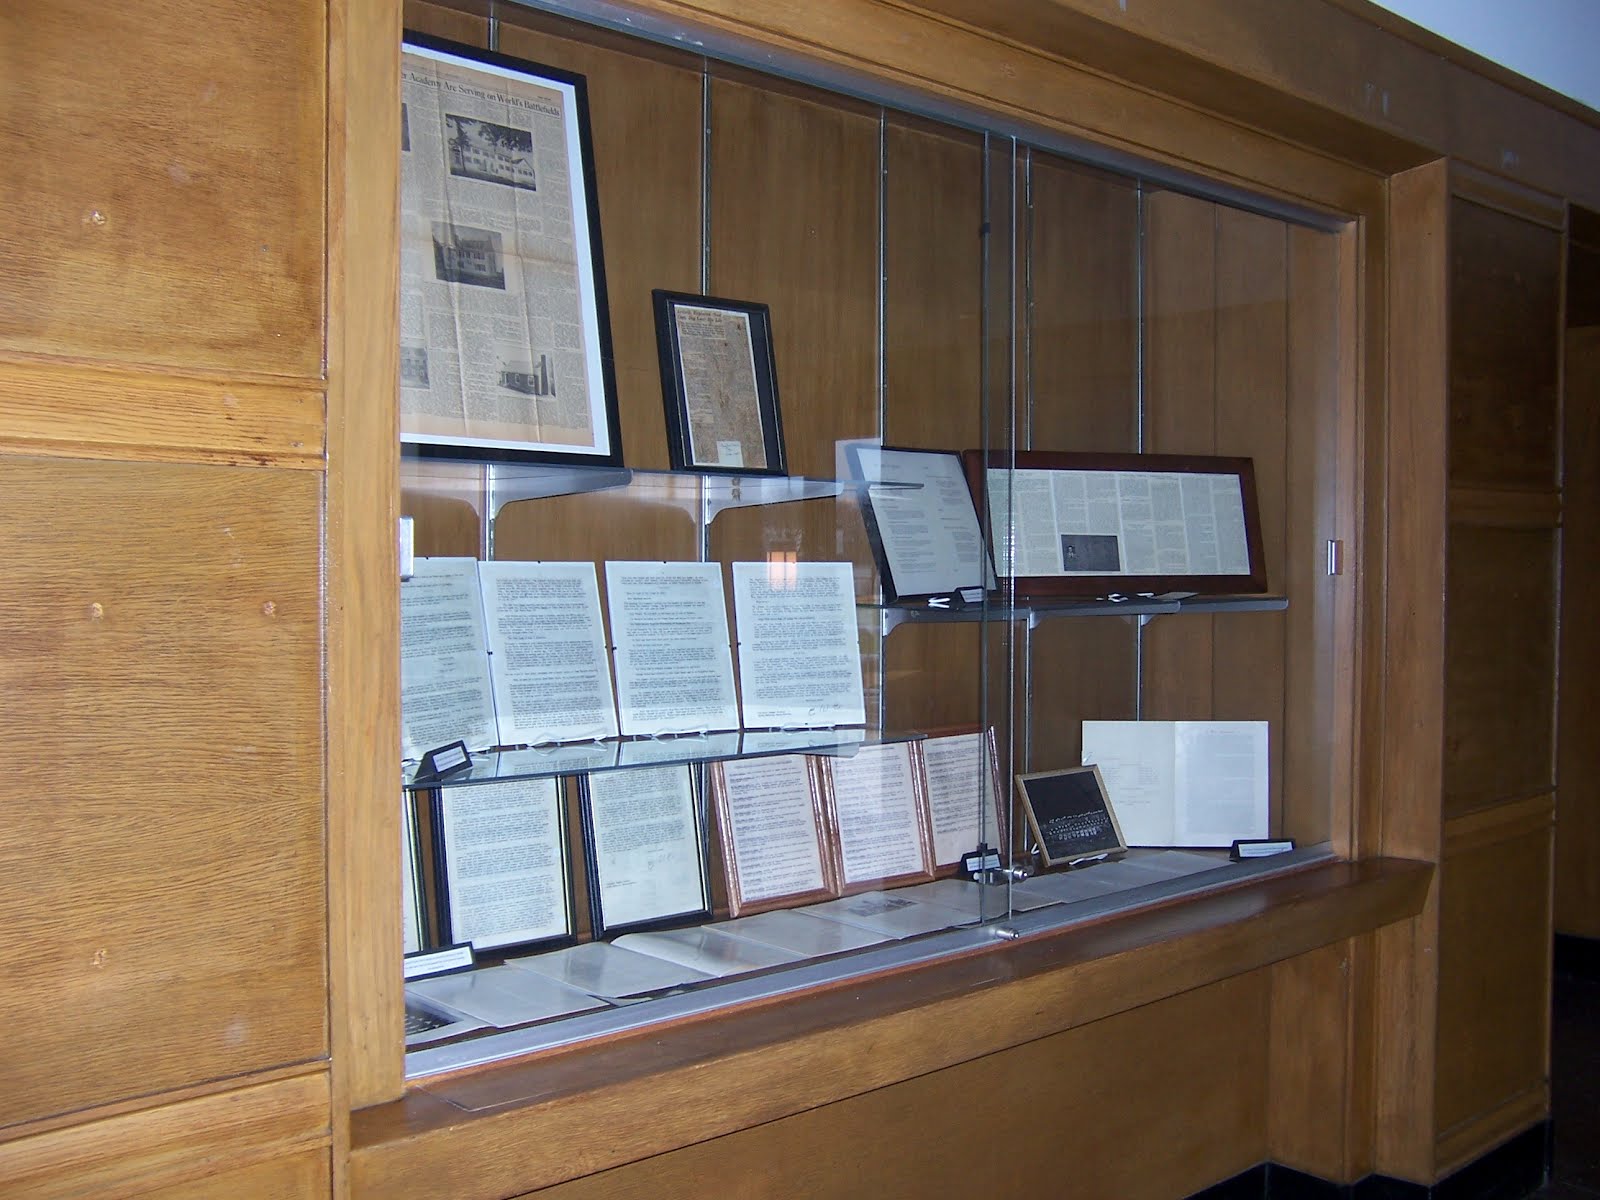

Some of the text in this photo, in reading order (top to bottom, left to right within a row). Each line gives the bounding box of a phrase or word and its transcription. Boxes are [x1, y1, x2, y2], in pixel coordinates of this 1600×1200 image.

[444, 81, 457, 92] Are
[459, 85, 486, 100] Serving
[487, 93, 497, 101] on
